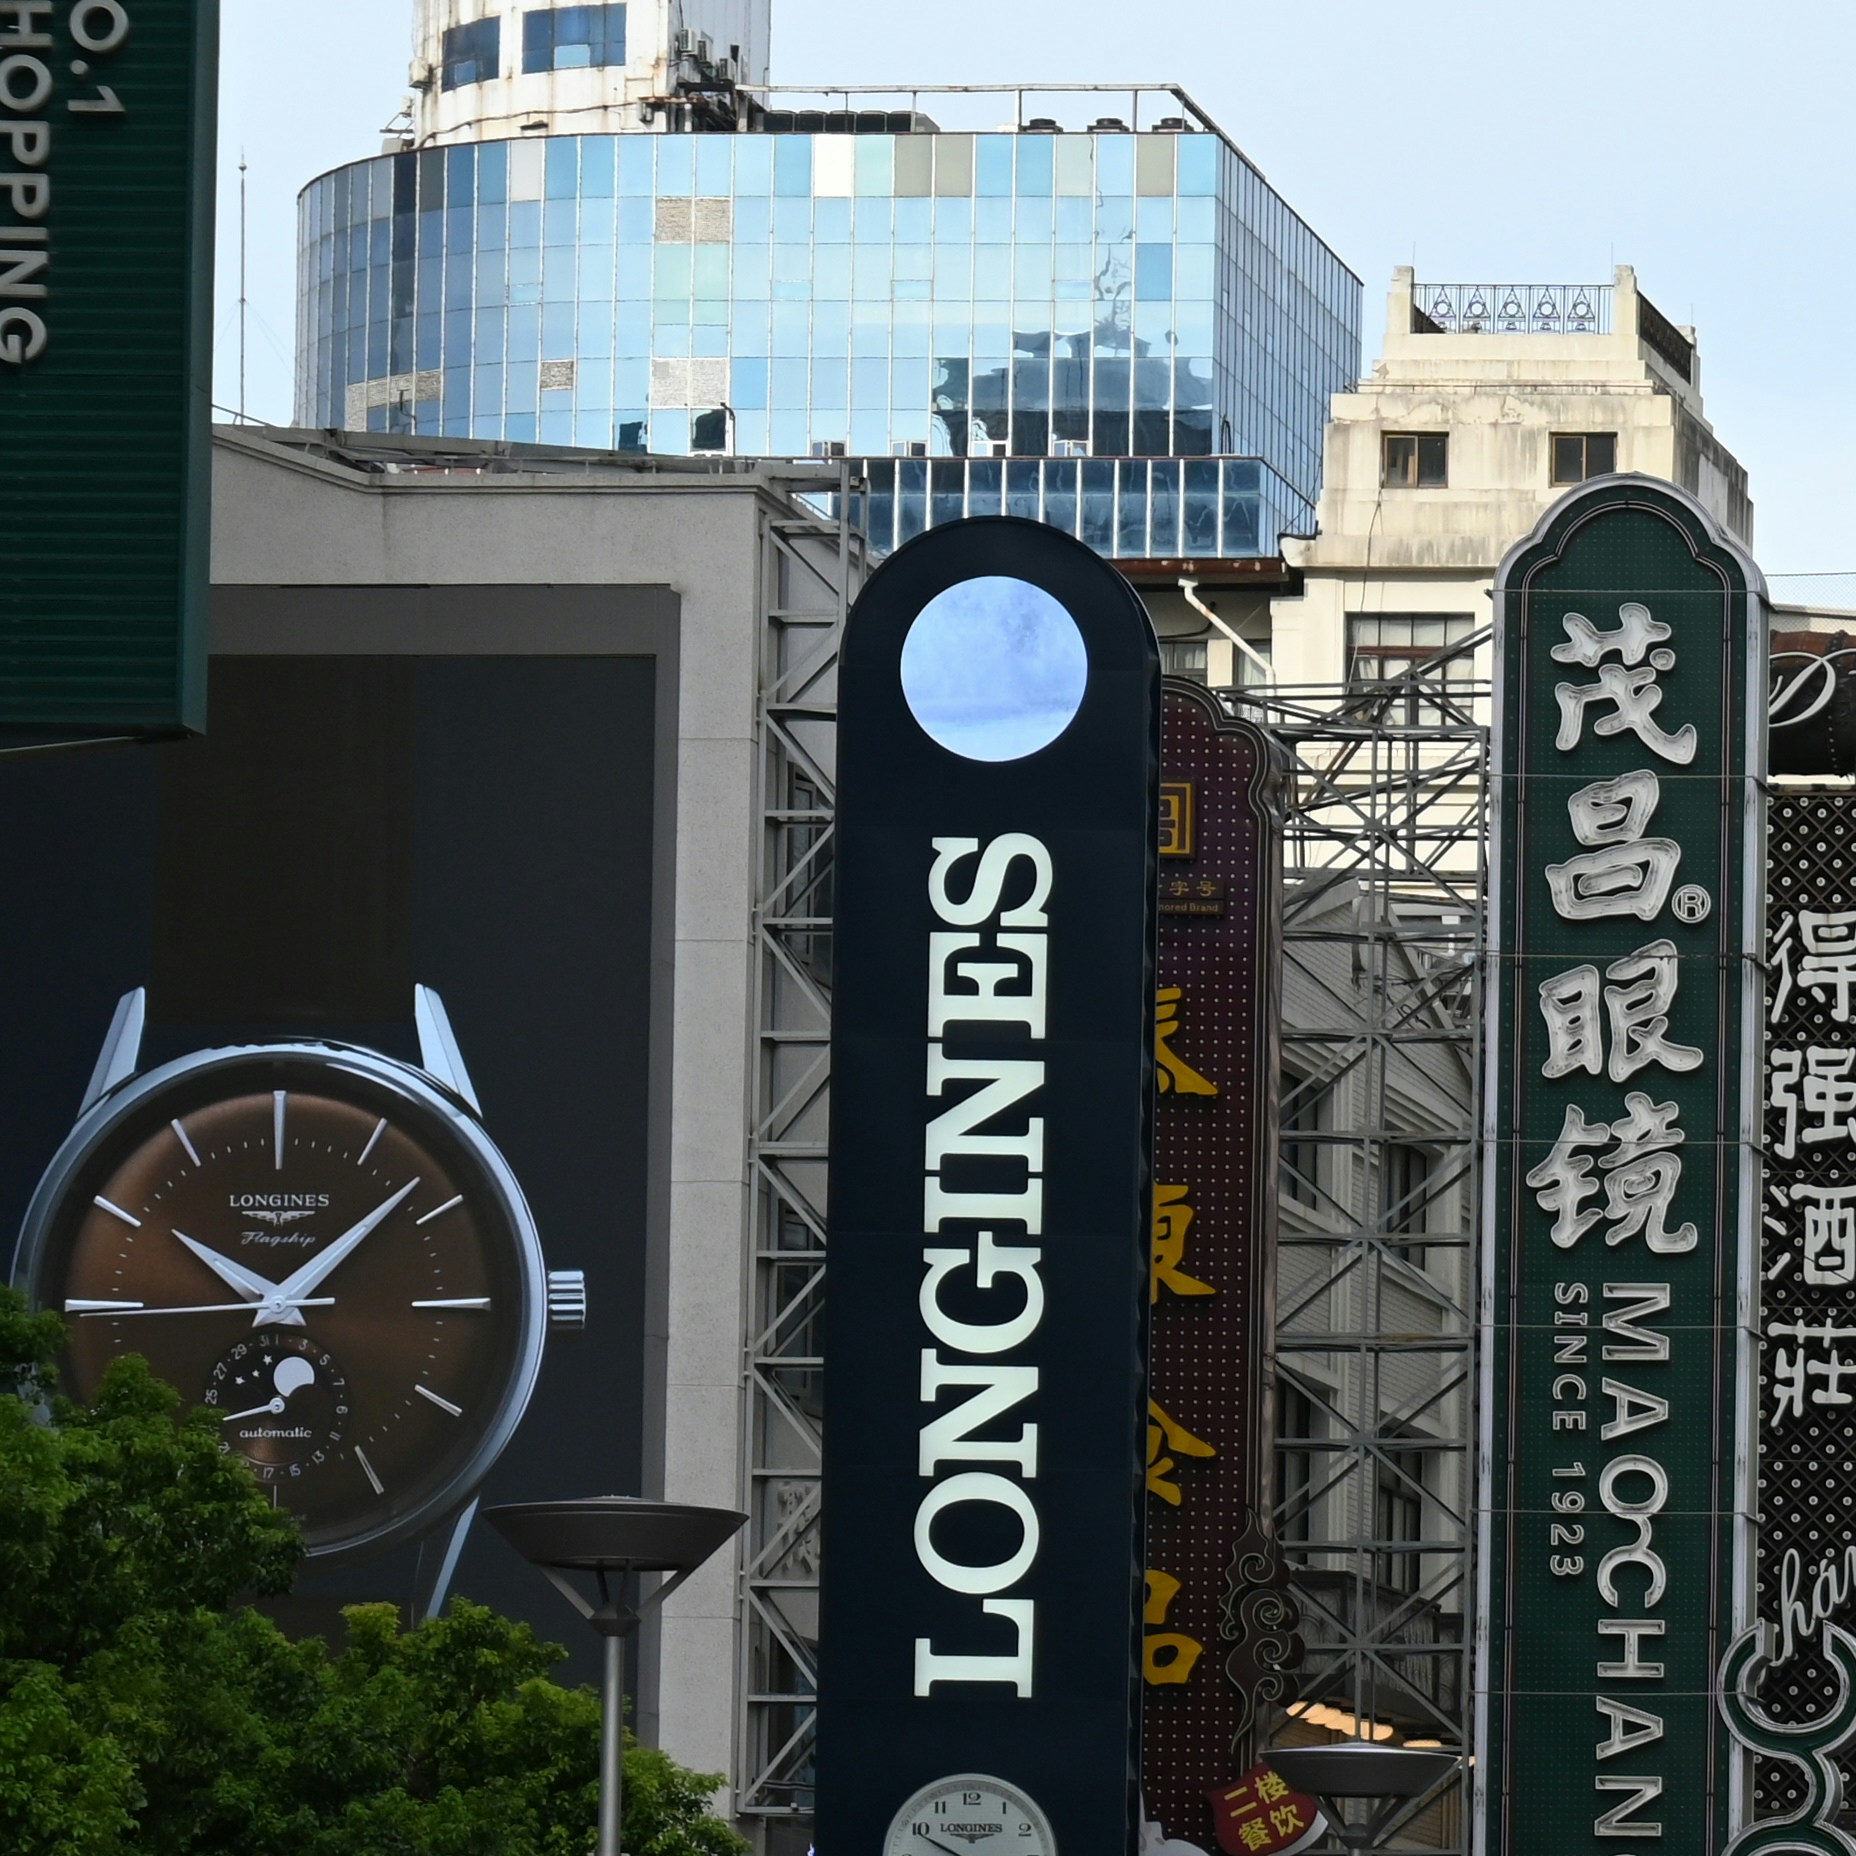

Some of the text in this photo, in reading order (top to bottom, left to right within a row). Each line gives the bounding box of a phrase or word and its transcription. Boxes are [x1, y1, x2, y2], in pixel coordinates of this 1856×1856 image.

[1526, 601, 1705, 1254] 茂昌眼镜
[229, 1194, 330, 1208] LONGINES
[241, 1231, 316, 1248] Flagship
[914, 832, 1054, 1698] LONGINES
[1550, 1281, 1589, 1433] SINCE
[239, 1427, 313, 1439] automatic
[1548, 1461, 1586, 1578] 1923
[1223, 1770, 1289, 1818] 二楼
[940, 1823, 1003, 1833] LONGINES
[1238, 1803, 1305, 1852] 餐饮
